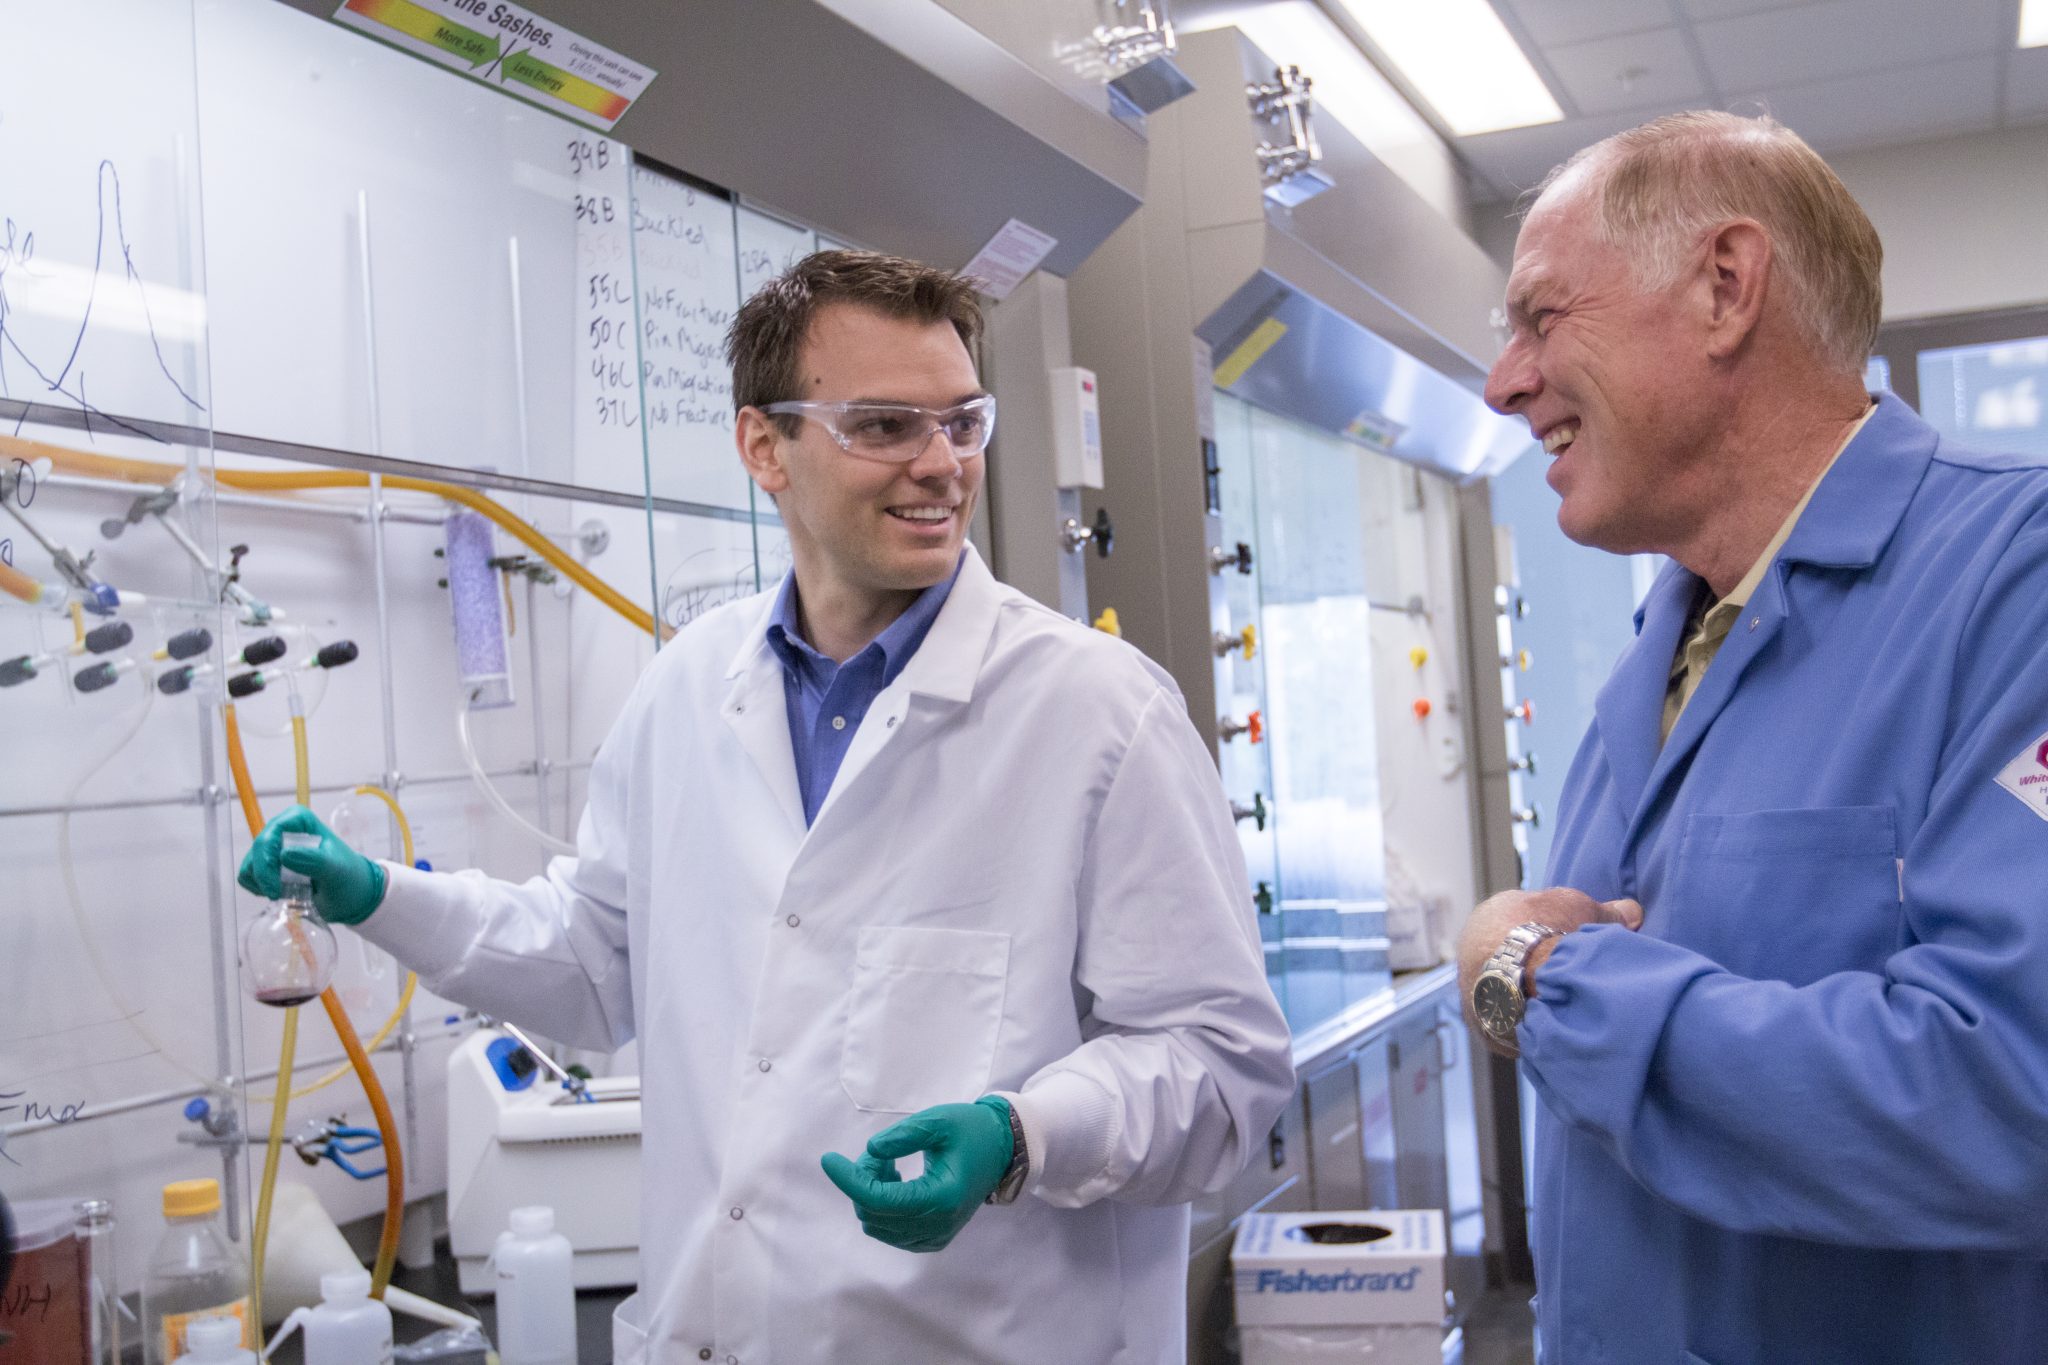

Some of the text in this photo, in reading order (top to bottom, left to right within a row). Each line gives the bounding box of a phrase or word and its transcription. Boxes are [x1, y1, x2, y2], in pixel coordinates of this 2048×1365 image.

[488, 4, 553, 49] Sashes.
[435, 27, 486, 56] More Safe
[513, 60, 567, 92] Less Energy
[574, 194, 615, 224] 38B
[2018, 773, 2048, 787] Whit
[1256, 1266, 1417, 1293] Fisherbrand
